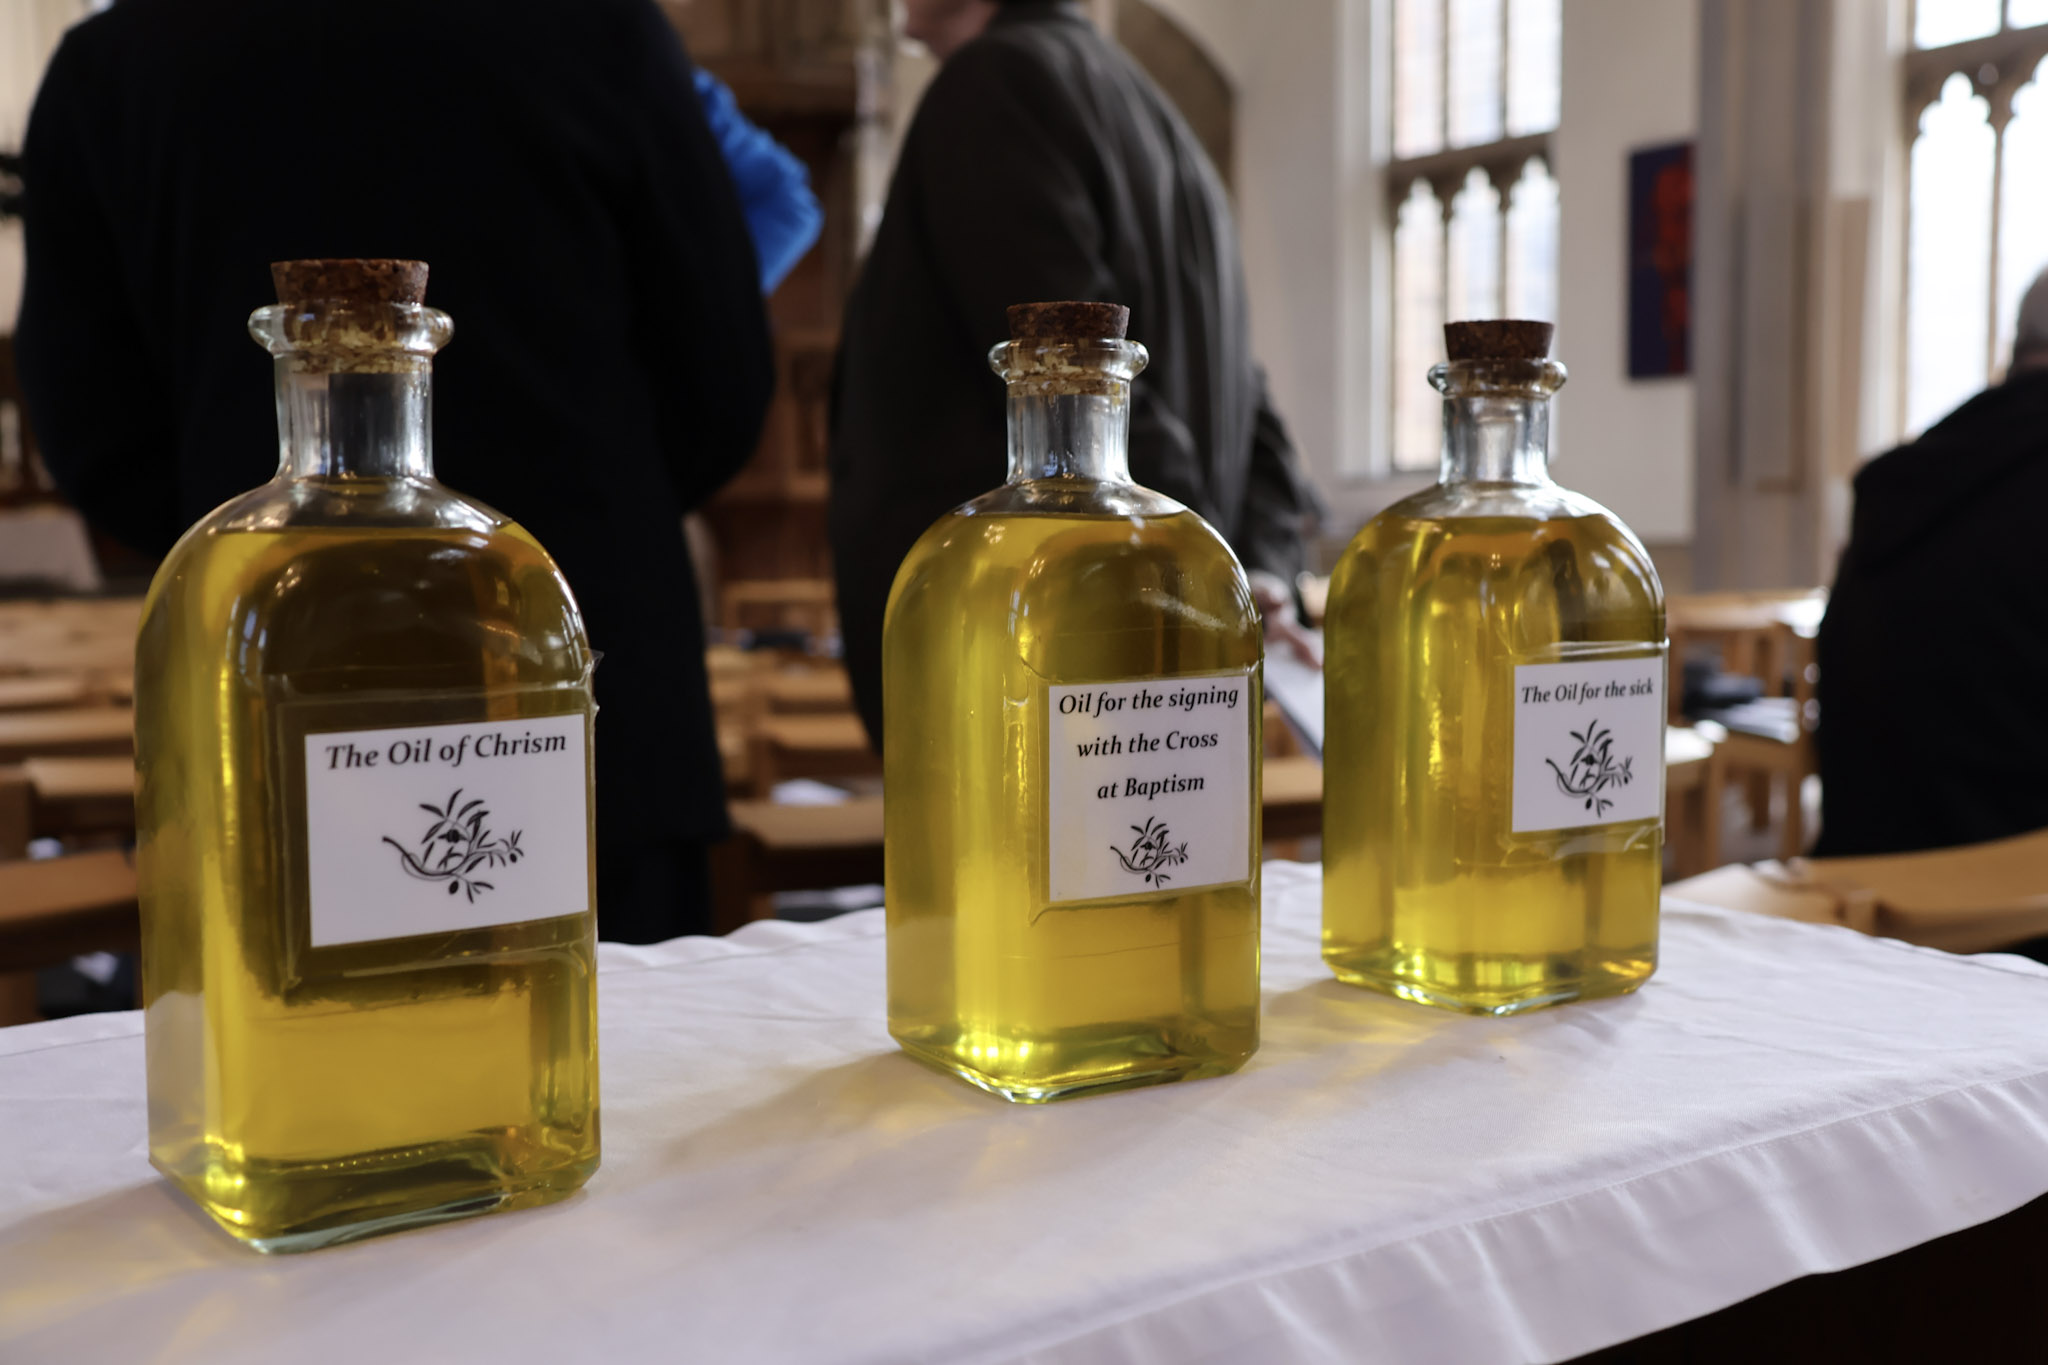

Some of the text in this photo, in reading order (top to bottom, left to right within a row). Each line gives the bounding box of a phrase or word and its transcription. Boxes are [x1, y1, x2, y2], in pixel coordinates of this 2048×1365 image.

[1059, 685, 1239, 719] Oil for the signing
[1521, 677, 1654, 705] The Oil for the sick
[326, 731, 567, 770] The Oil of Chrism
[1077, 730, 1219, 757] with the Cross
[1097, 773, 1205, 801] at Baptism
